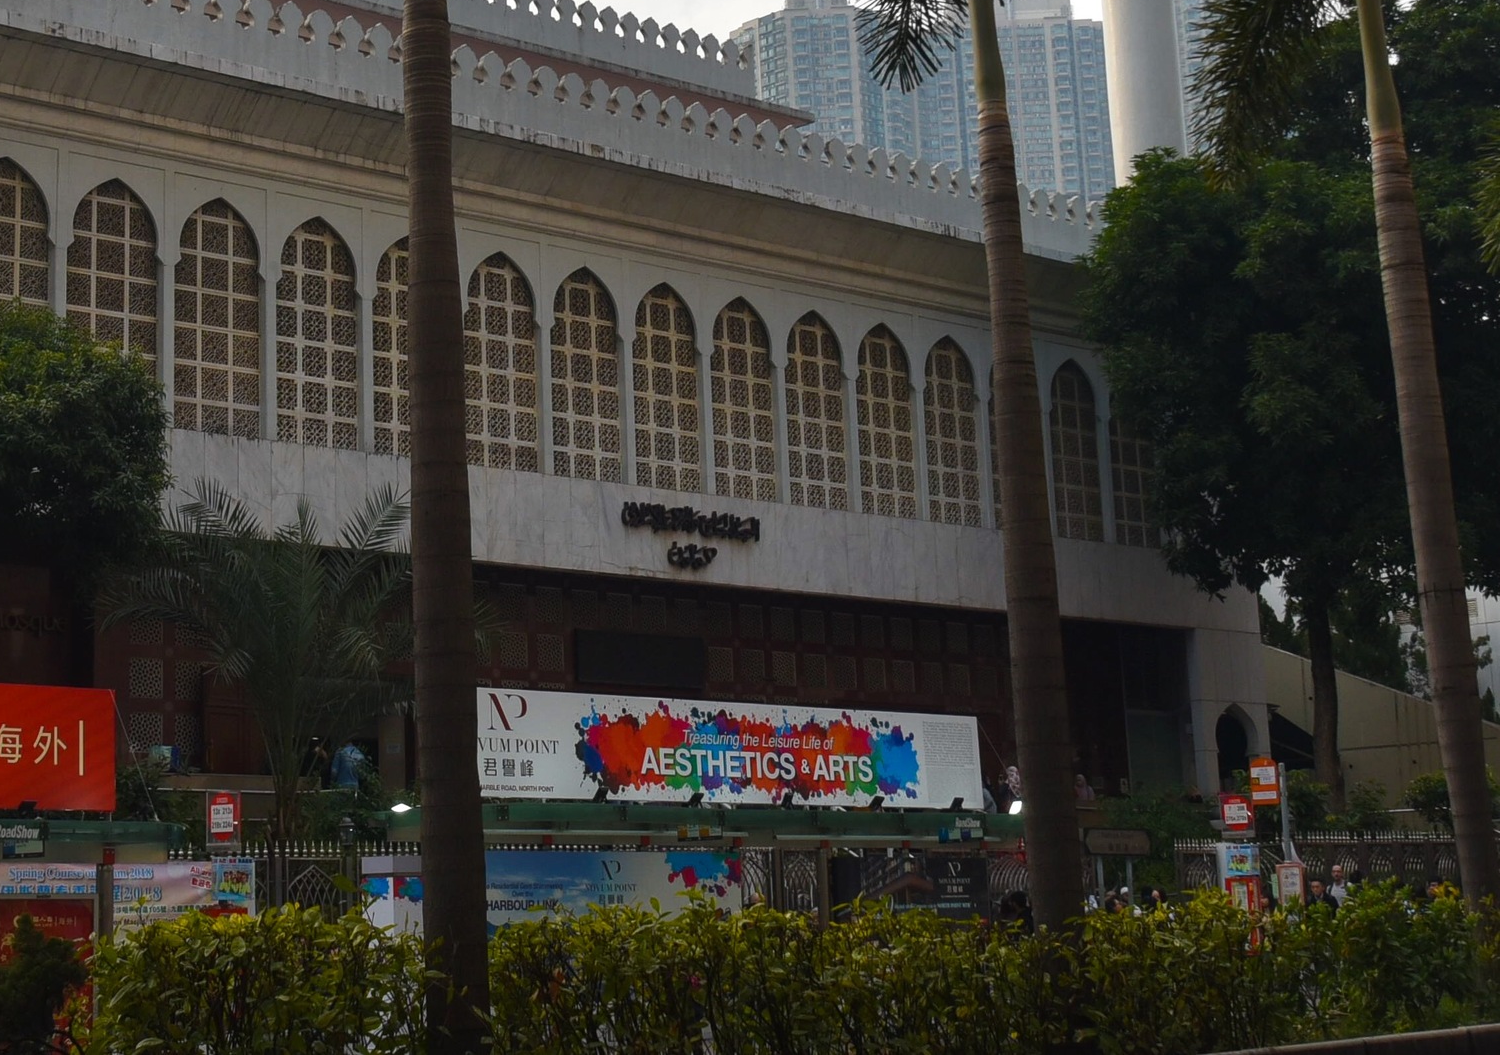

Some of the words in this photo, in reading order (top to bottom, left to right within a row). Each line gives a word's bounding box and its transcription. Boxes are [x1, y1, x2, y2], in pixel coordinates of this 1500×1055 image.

[477, 737, 511, 753] VUM
[515, 739, 559, 754] POINT
[683, 730, 739, 749] Treasuring
[743, 733, 759, 746] the
[762, 734, 799, 748] Leisure
[802, 736, 821, 750] Life
[823, 737, 834, 751] of
[641, 747, 796, 779] AESTHETICS
[800, 759, 810, 774] &
[813, 755, 873, 783] ARTS
[8, 867, 45, 882] Spring
[47, 867, 83, 879] Course
[85, 871, 97, 879] on
[128, 867, 154, 880] 2018
[615, 883, 637, 892] POINT
